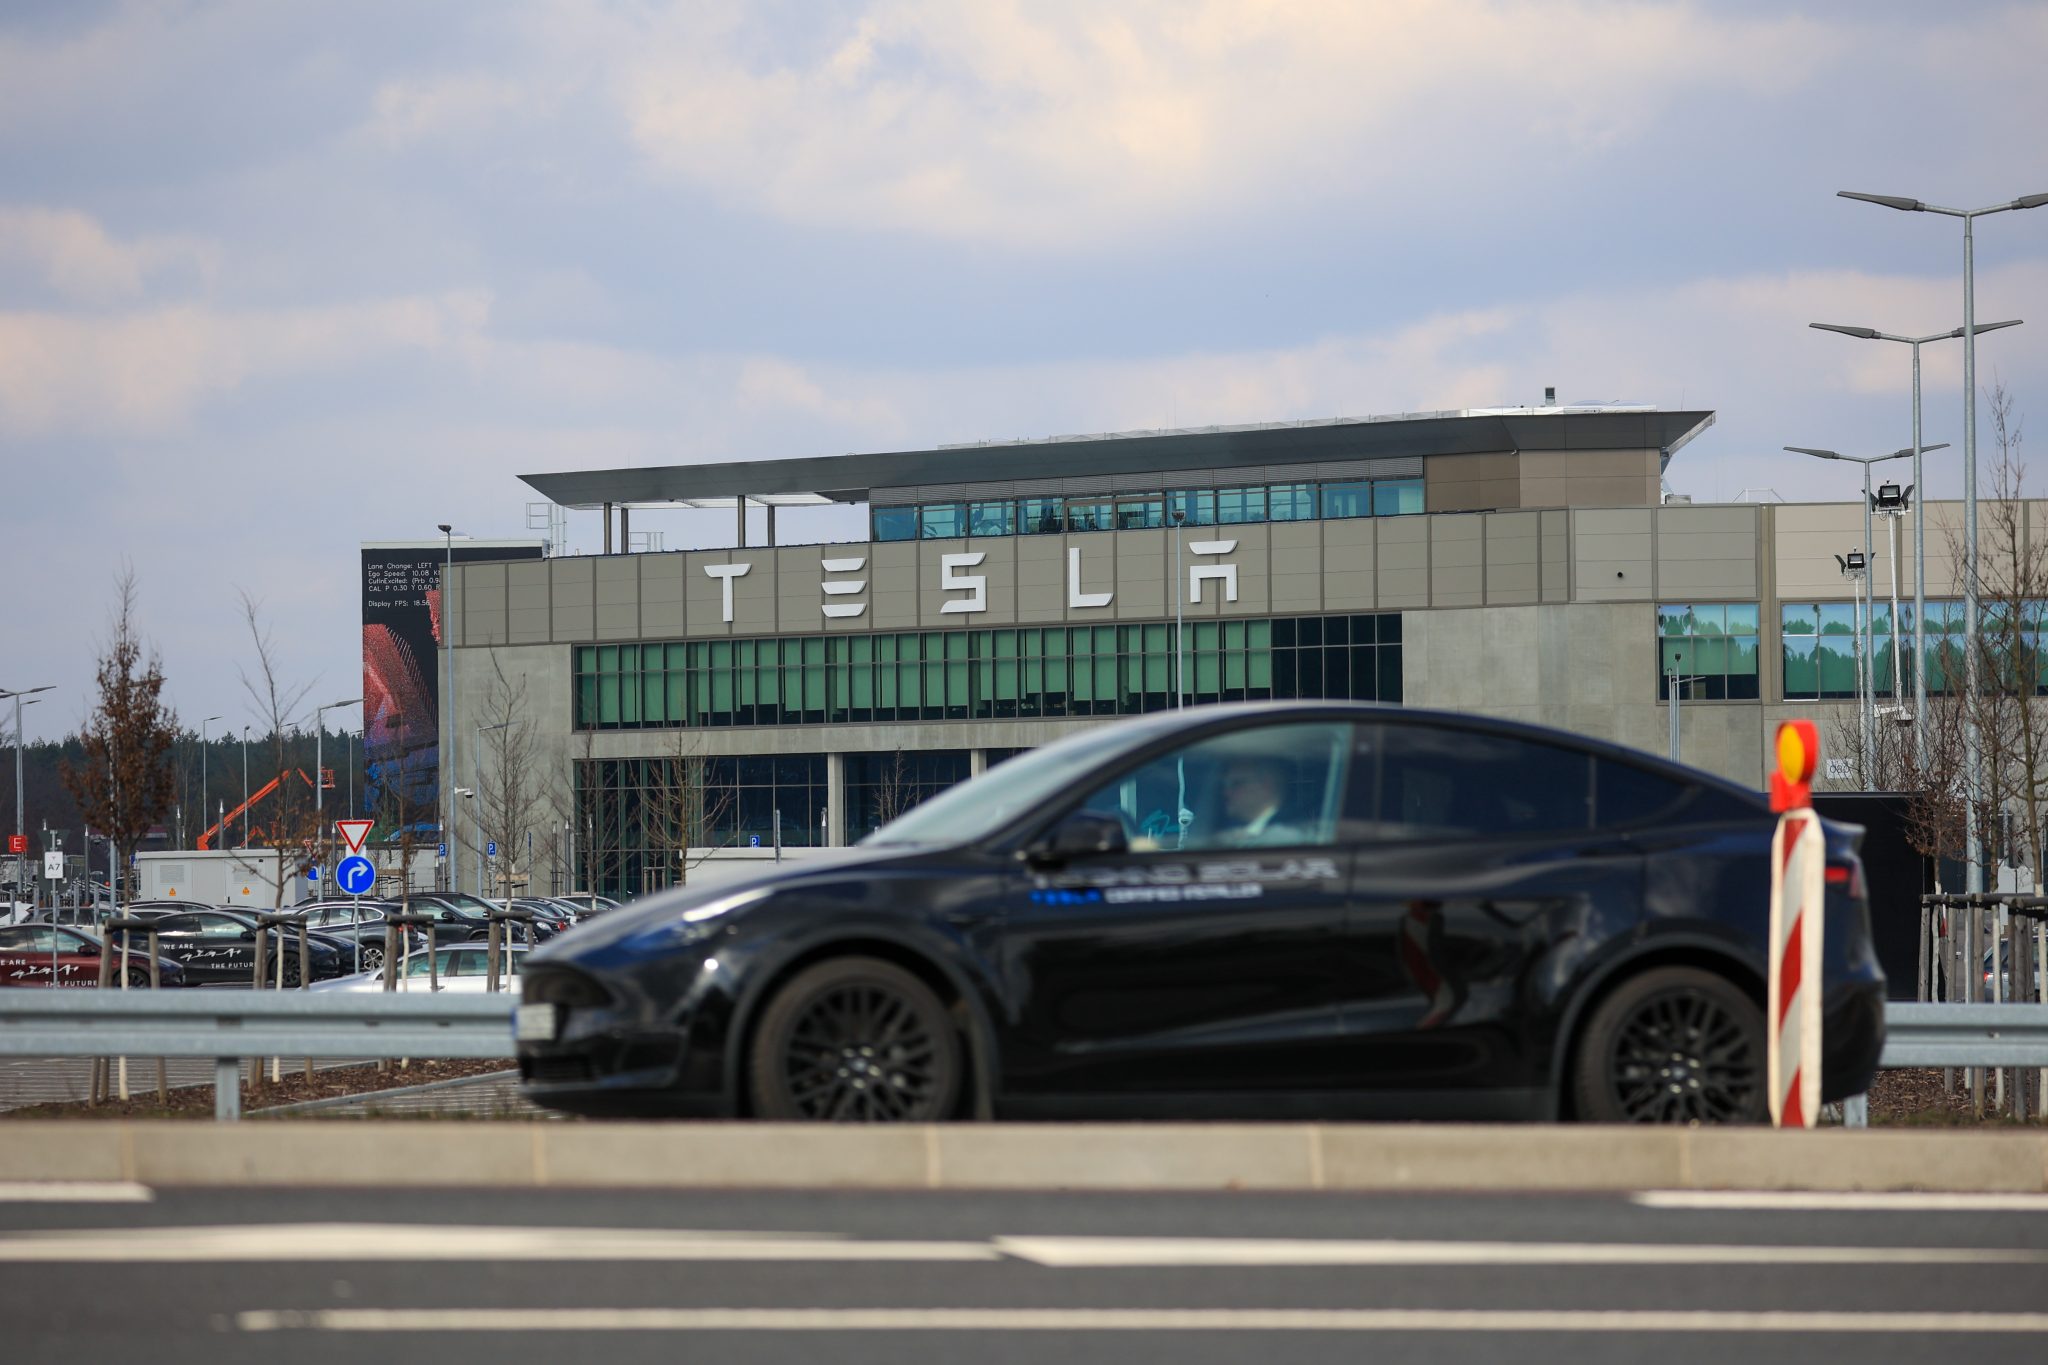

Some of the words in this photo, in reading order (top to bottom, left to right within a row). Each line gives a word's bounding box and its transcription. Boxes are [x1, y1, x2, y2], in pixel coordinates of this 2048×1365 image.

[704, 540, 1238, 622] TESLA
[368, 600, 391, 608] Display
[14, 838, 22, 848] E
